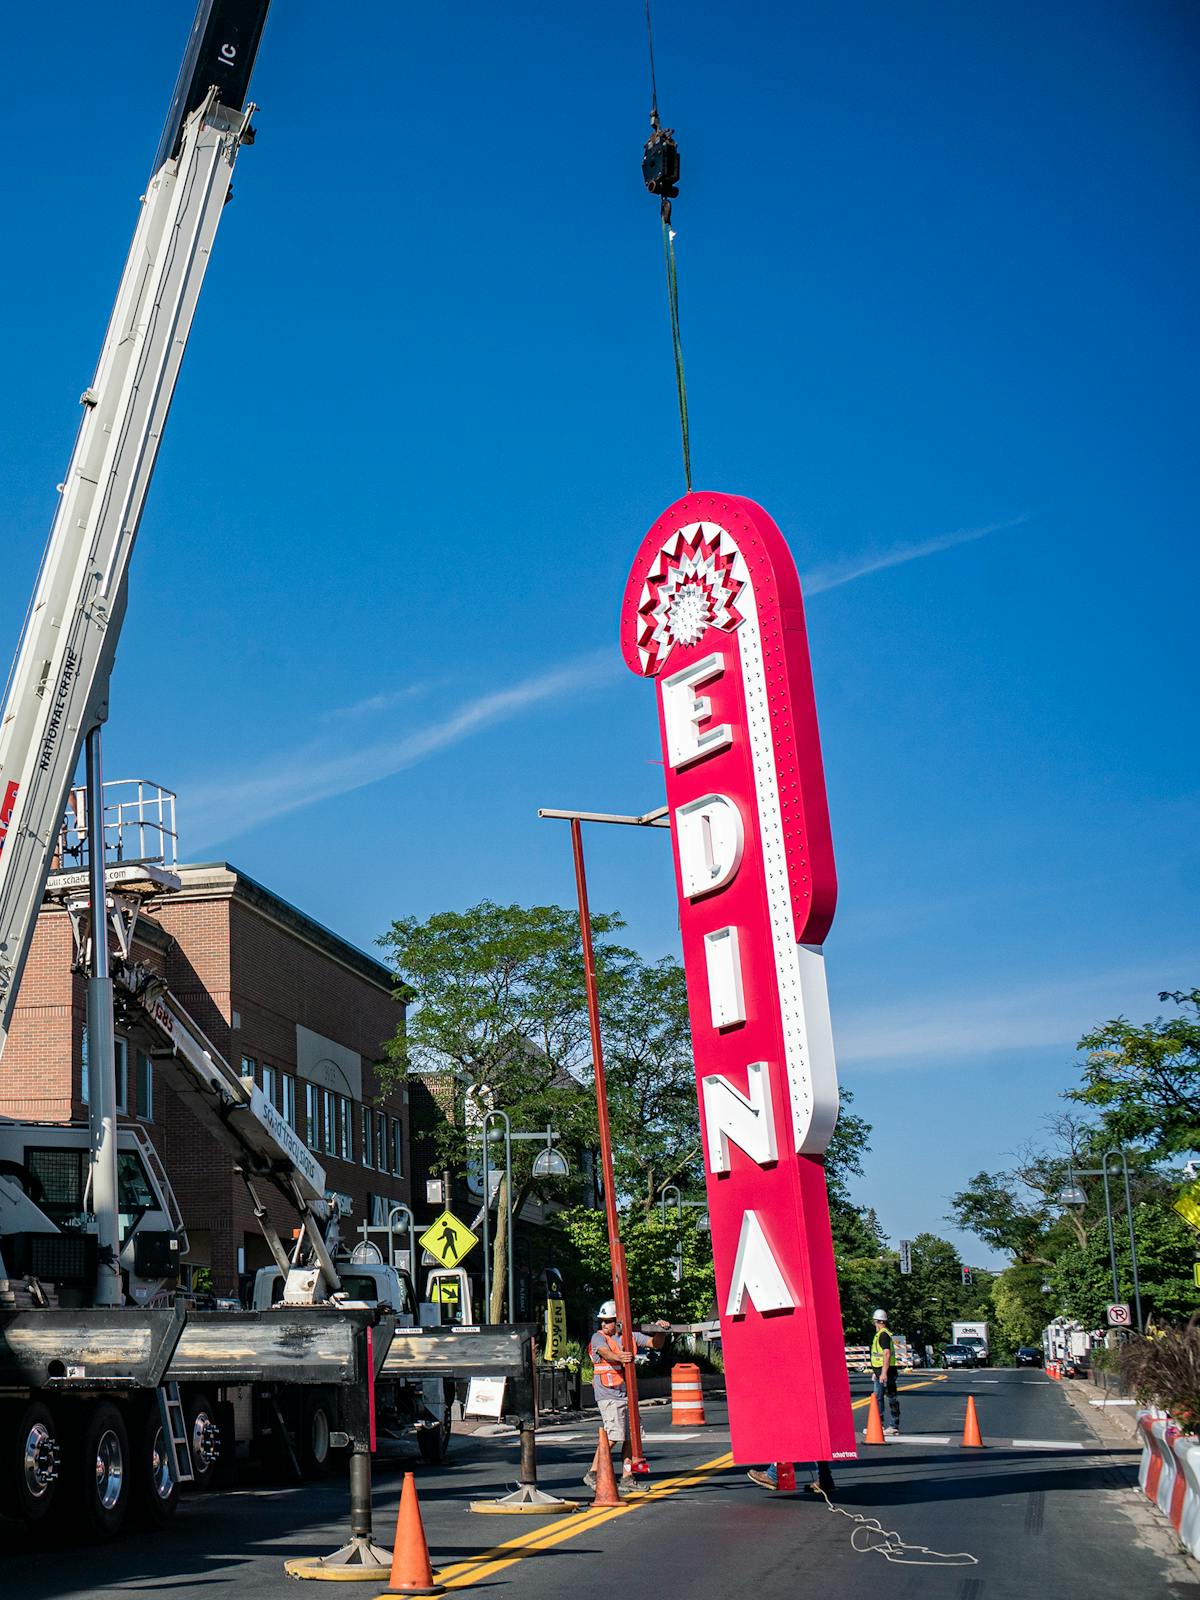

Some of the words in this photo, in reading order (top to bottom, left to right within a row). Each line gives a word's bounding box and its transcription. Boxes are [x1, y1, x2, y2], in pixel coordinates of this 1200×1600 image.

[40, 699, 65, 771] NATIONAL
[59, 650, 78, 698] CRANE
[661, 652, 795, 1316] EDINA
